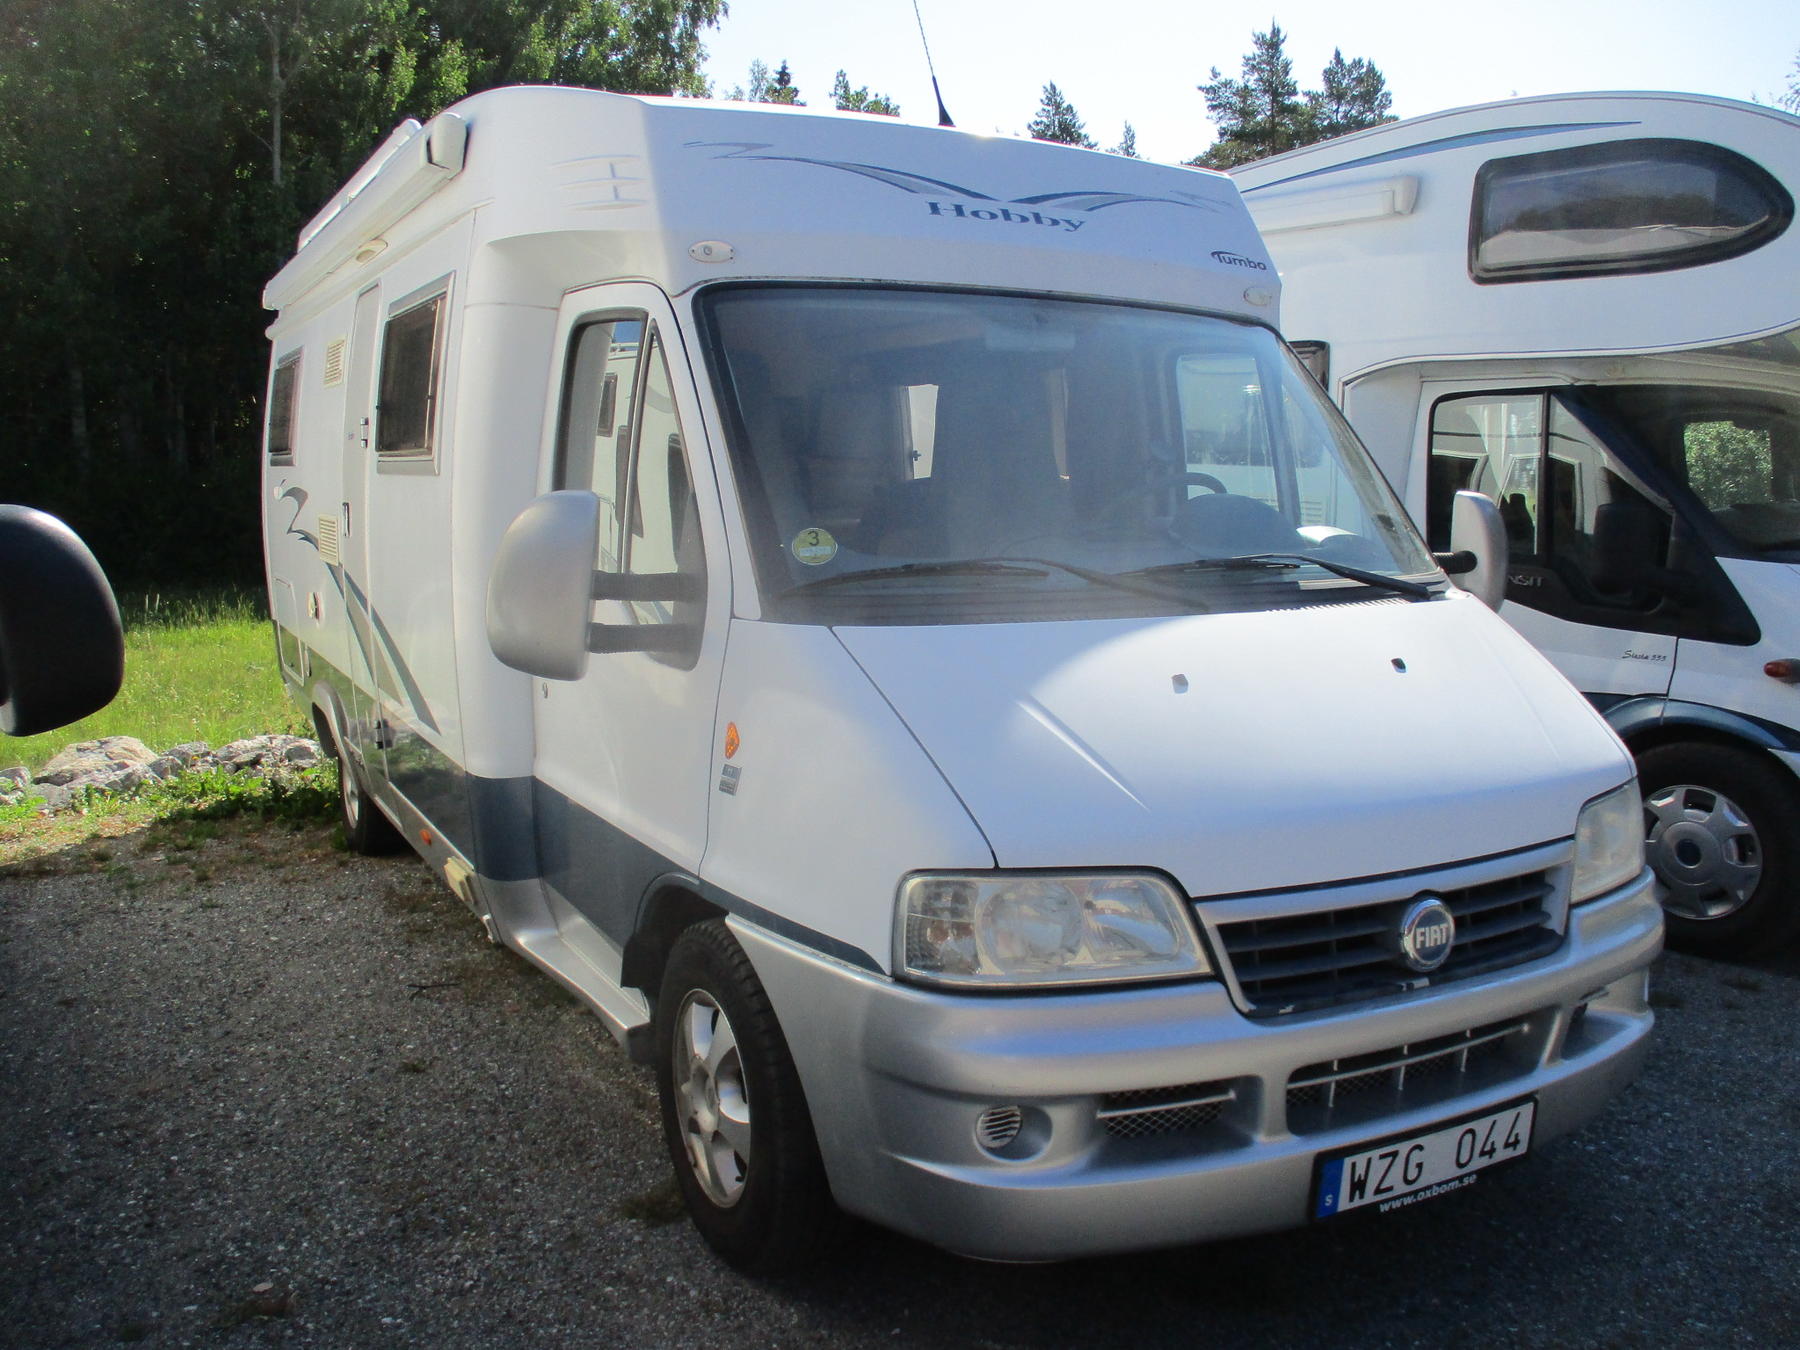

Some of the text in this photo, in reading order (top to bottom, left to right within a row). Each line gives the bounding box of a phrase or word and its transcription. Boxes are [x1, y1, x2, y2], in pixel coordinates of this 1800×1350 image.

[928, 201, 1085, 233] Hobby
[1210, 250, 1267, 271] Tumbo
[807, 530, 820, 547] 3
[1415, 923, 1448, 949] FIAT
[1348, 1111, 1521, 1203] WZG 044
[1324, 1194, 1334, 1207] S
[1379, 1173, 1478, 1213] www.oxbom.se
